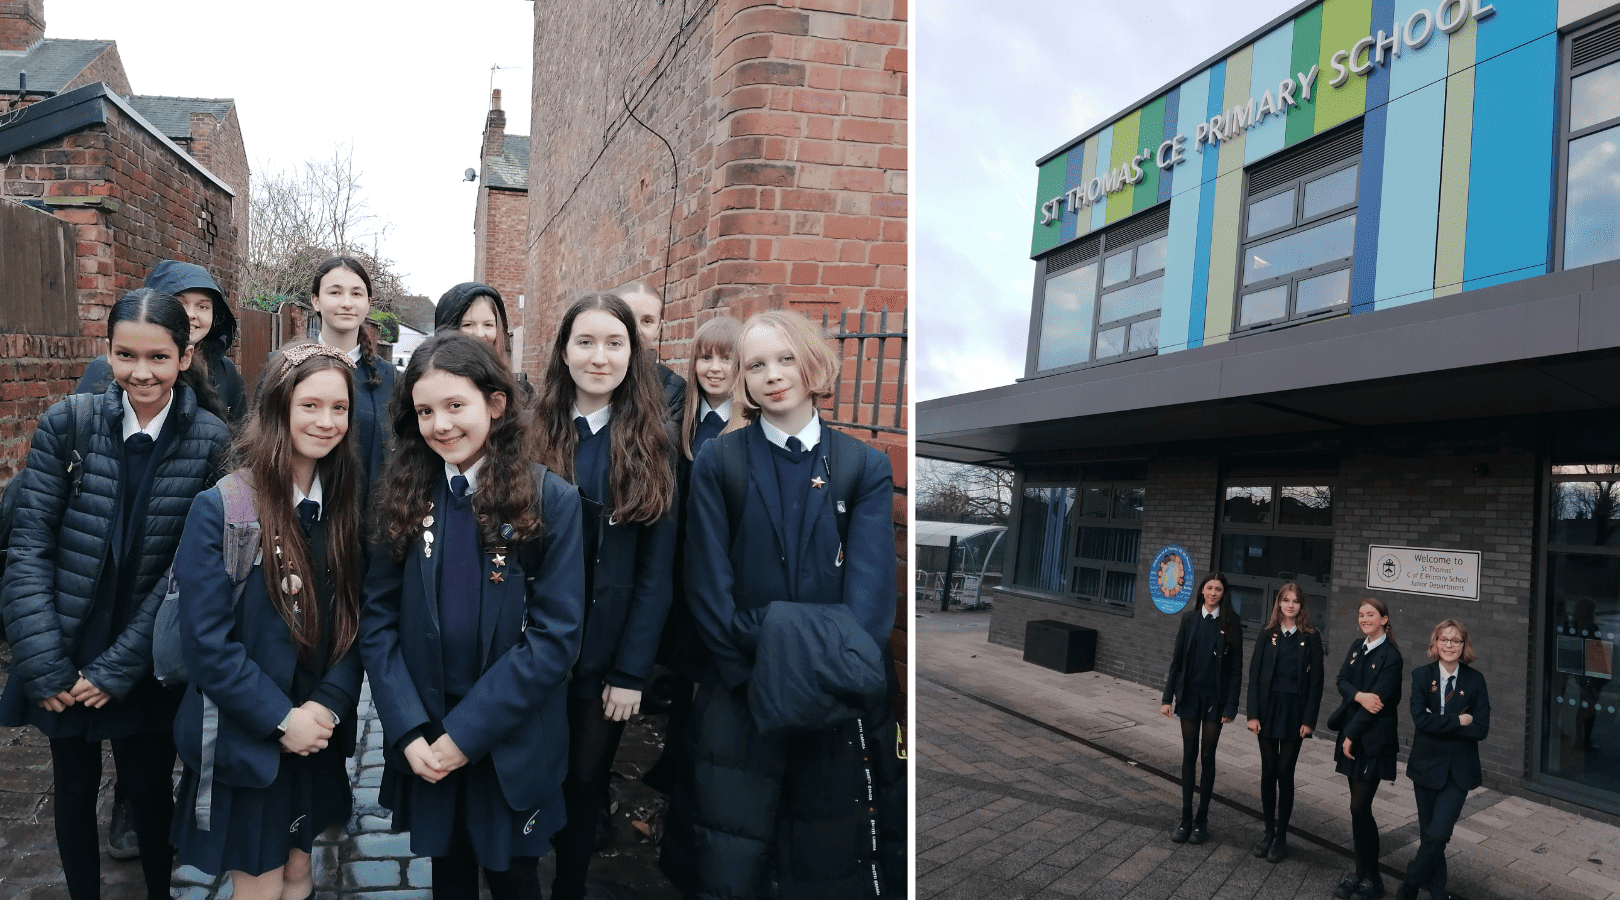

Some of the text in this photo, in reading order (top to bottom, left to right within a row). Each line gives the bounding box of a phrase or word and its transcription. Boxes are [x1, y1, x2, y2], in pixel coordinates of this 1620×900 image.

[1040, 0, 1496, 226] ST THOMAS' CE PRIMARY SCHOOL
[1414, 554, 1464, 566] Welcome to
[1425, 573, 1448, 582] Primary
[1449, 575, 1469, 584] School
[1429, 581, 1465, 592] Department
